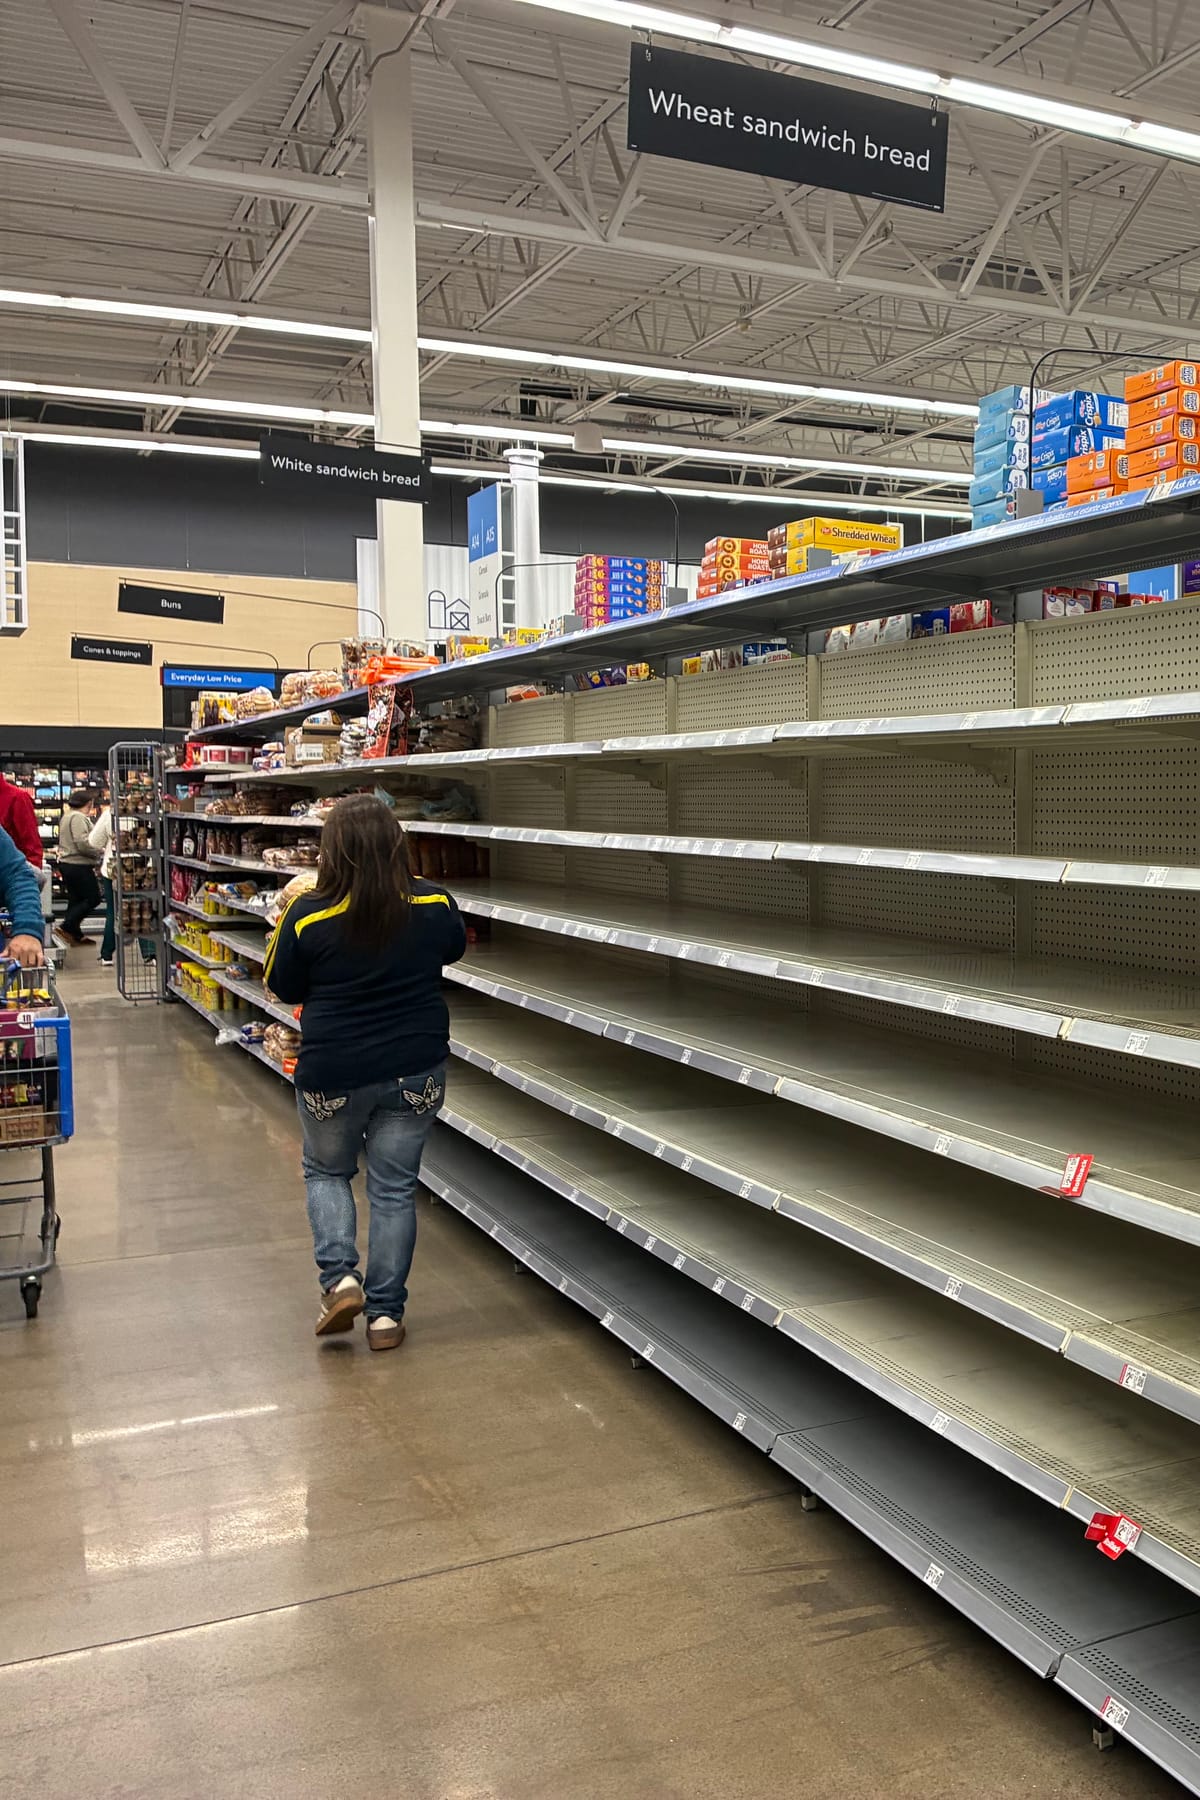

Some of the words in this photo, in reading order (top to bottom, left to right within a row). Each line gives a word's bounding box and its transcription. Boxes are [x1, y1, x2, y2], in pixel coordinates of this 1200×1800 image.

[648, 88, 735, 129] Wheat
[742, 112, 857, 156] sandwich
[864, 134, 931, 172] bread
[1085, 394, 1094, 426] Crispix
[271, 455, 313, 473] White
[316, 465, 379, 482] sandwich
[382, 470, 420, 487] bread
[1173, 479, 1186, 491] Ask
[1186, 476, 1197, 487] for
[832, 527, 870, 541] Shredded
[870, 533, 897, 544] Wheat
[161, 599, 182, 610] Buns
[112, 648, 141, 659] toppings
[171, 672, 206, 683] Everyday
[207, 674, 222, 683] Low
[223, 674, 242, 683] Price
[1072, 1159, 1088, 1192] Rollback
